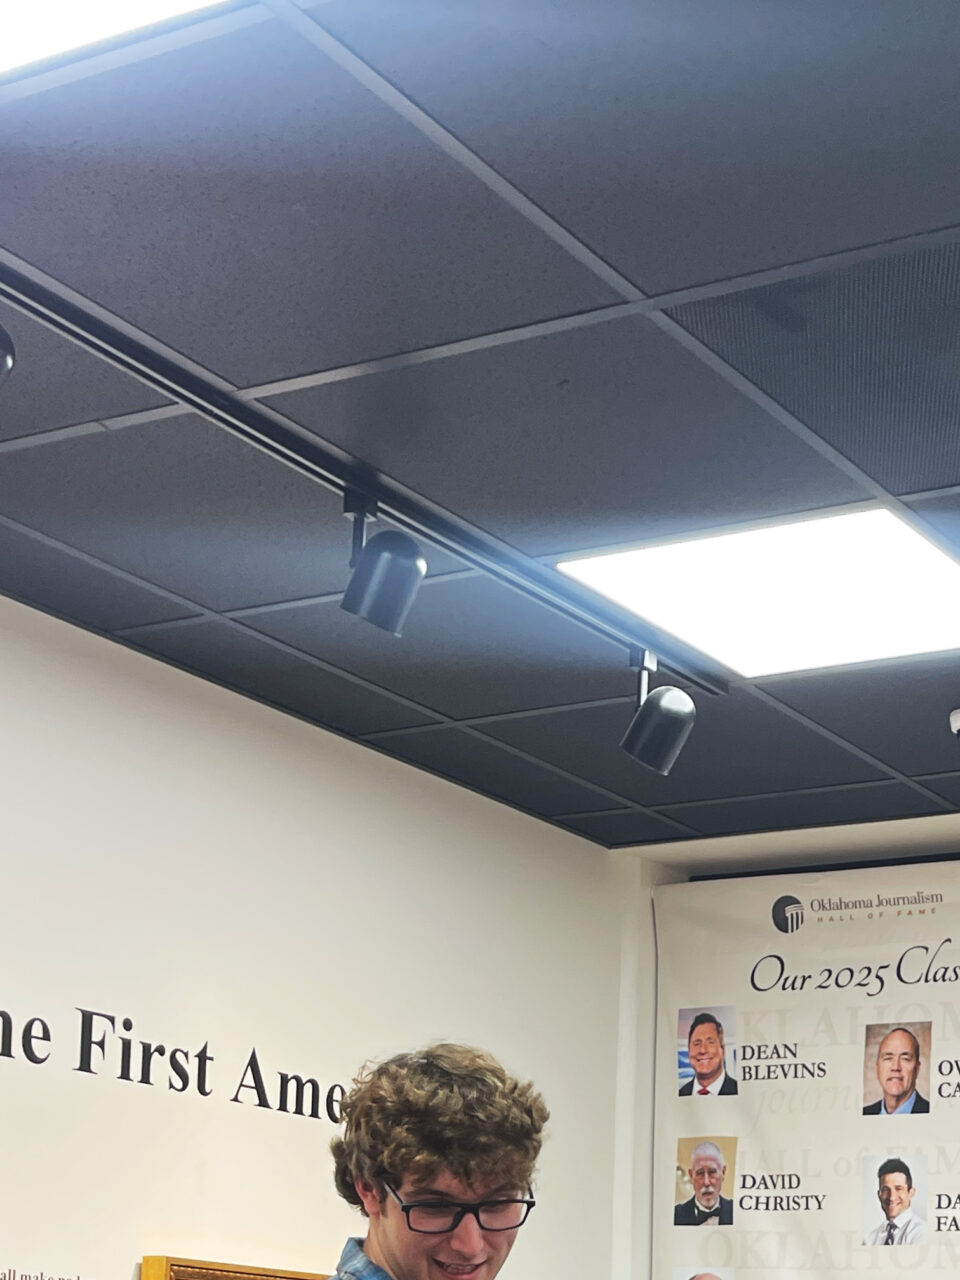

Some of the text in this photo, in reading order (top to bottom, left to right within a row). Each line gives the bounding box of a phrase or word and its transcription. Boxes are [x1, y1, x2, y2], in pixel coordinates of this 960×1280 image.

[810, 891, 943, 913] Oklahoma Journalism
[817, 907, 937, 923] HALL OF FAME
[750, 954, 812, 992] Our
[814, 963, 891, 997] 2025
[740, 1043, 799, 1061] DEAN
[72, 1007, 214, 1097] First
[230, 1047, 348, 1124] Ame
[740, 1062, 827, 1081] BLEVINS
[740, 1173, 801, 1190] DAVID
[738, 1194, 827, 1212] CHRISTY
